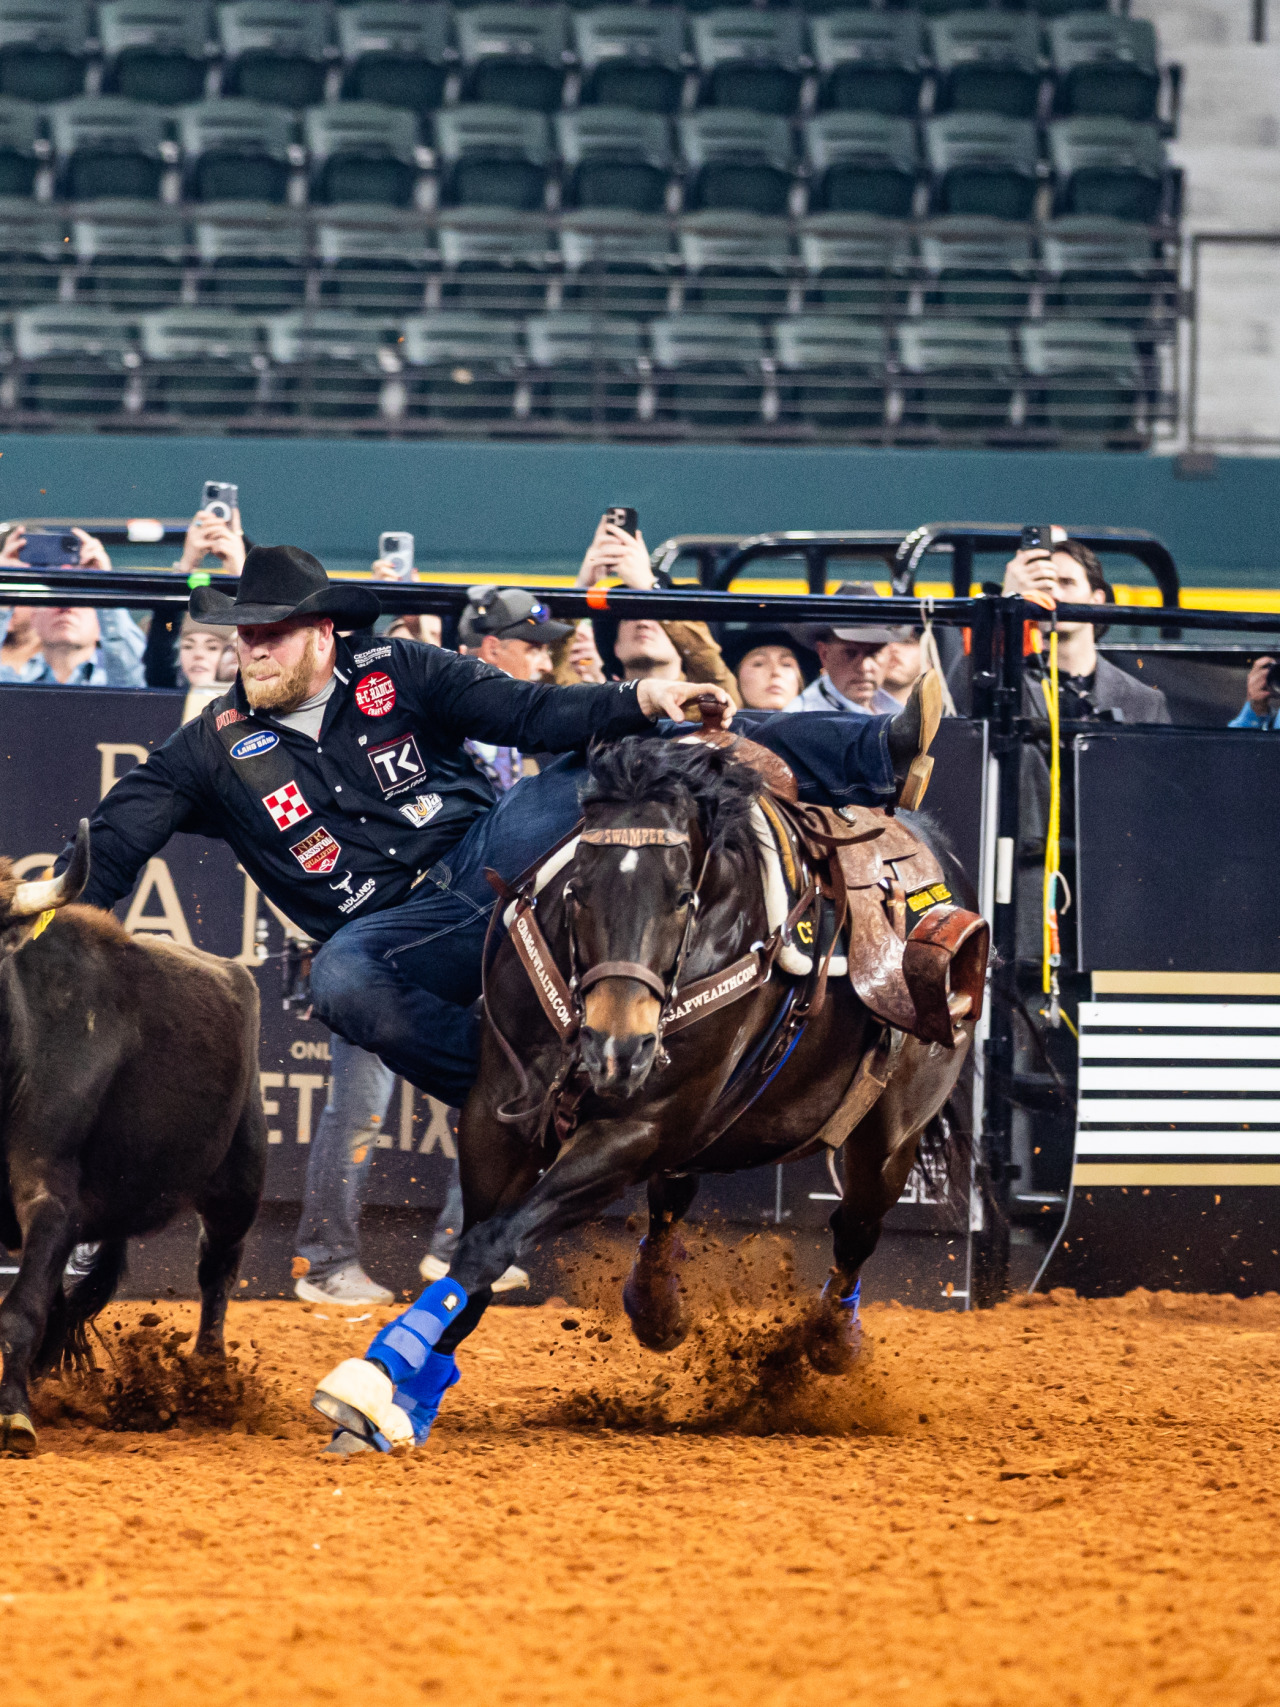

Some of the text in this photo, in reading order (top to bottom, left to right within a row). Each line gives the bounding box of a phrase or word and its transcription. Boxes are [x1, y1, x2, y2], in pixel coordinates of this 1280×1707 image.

[355, 679, 395, 705] R-C RANCH
[237, 743, 257, 756] LAND
[256, 735, 276, 748] BANK
[298, 831, 325, 855] NFR
[298, 836, 334, 863] RESISTOL
[604, 828, 665, 847] SWAMPER
[304, 843, 338, 869] QUALIFIER
[337, 878, 376, 912] BADLANDS
[290, 1041, 332, 1061] ONL
